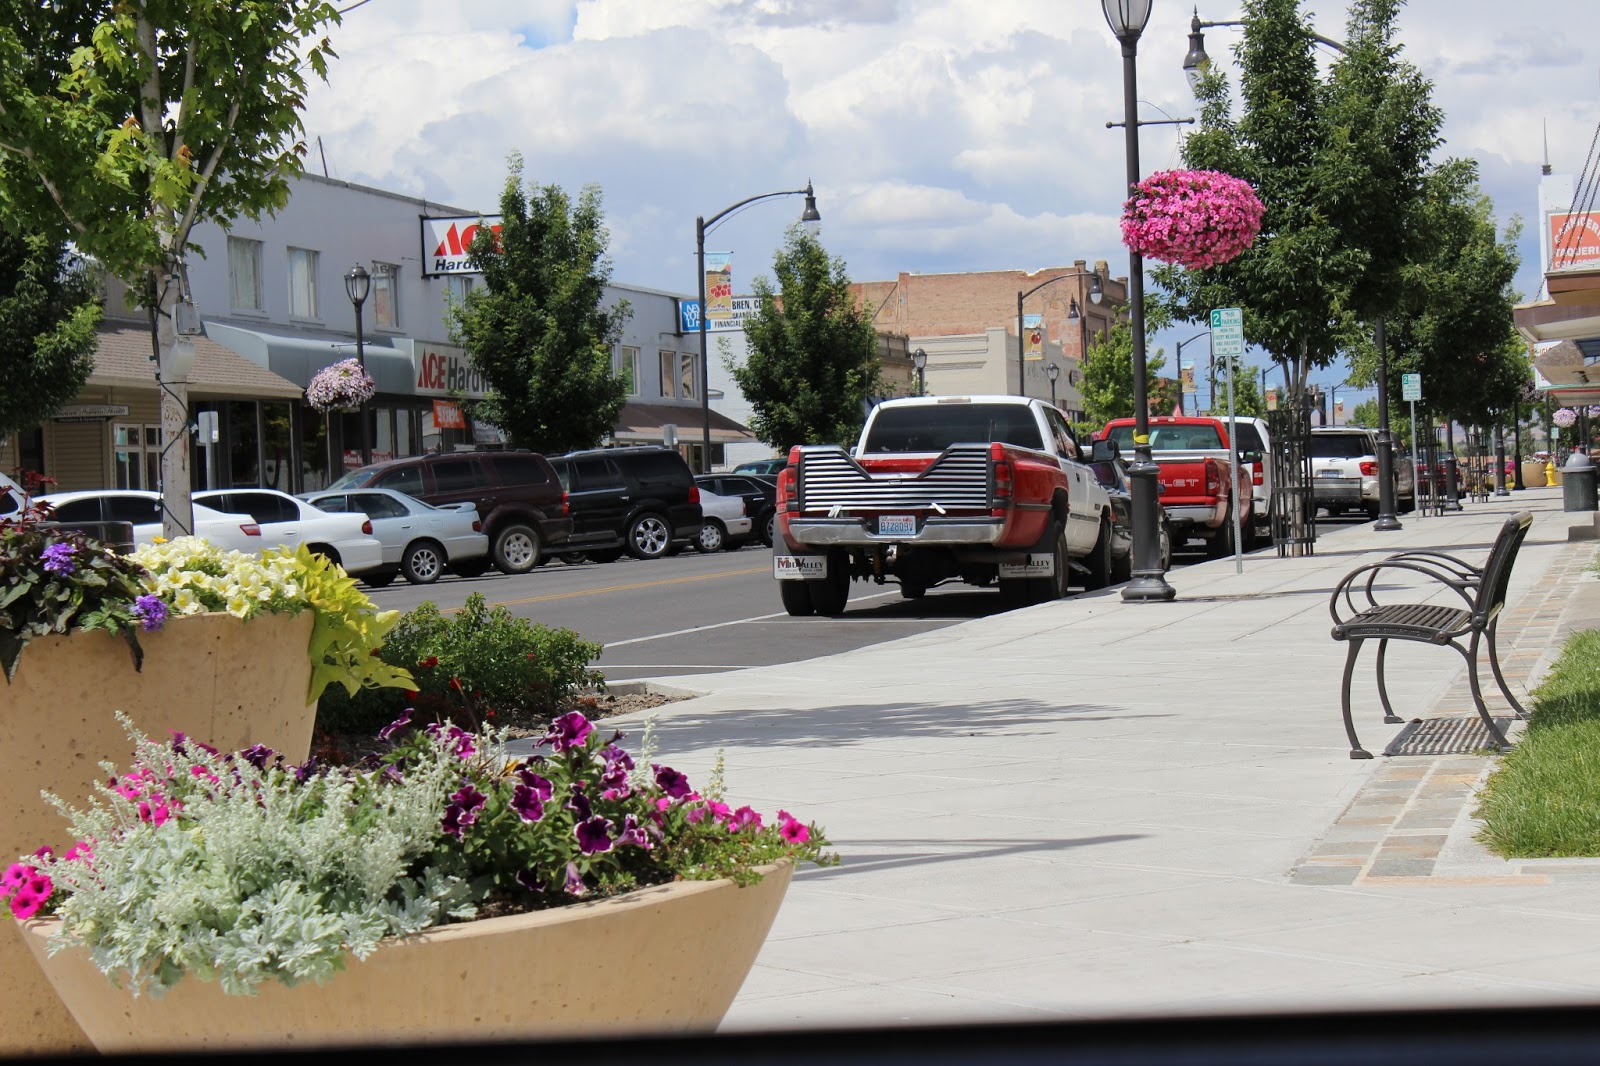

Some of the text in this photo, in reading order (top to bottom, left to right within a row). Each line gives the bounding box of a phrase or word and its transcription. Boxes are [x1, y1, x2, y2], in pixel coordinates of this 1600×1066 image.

[1555, 246, 1600, 257] TAQUERI
[714, 319, 741, 328] FINANCIAL
[1213, 313, 1220, 325] 2
[417, 347, 446, 390] ACE
[1158, 479, 1200, 487] LET
